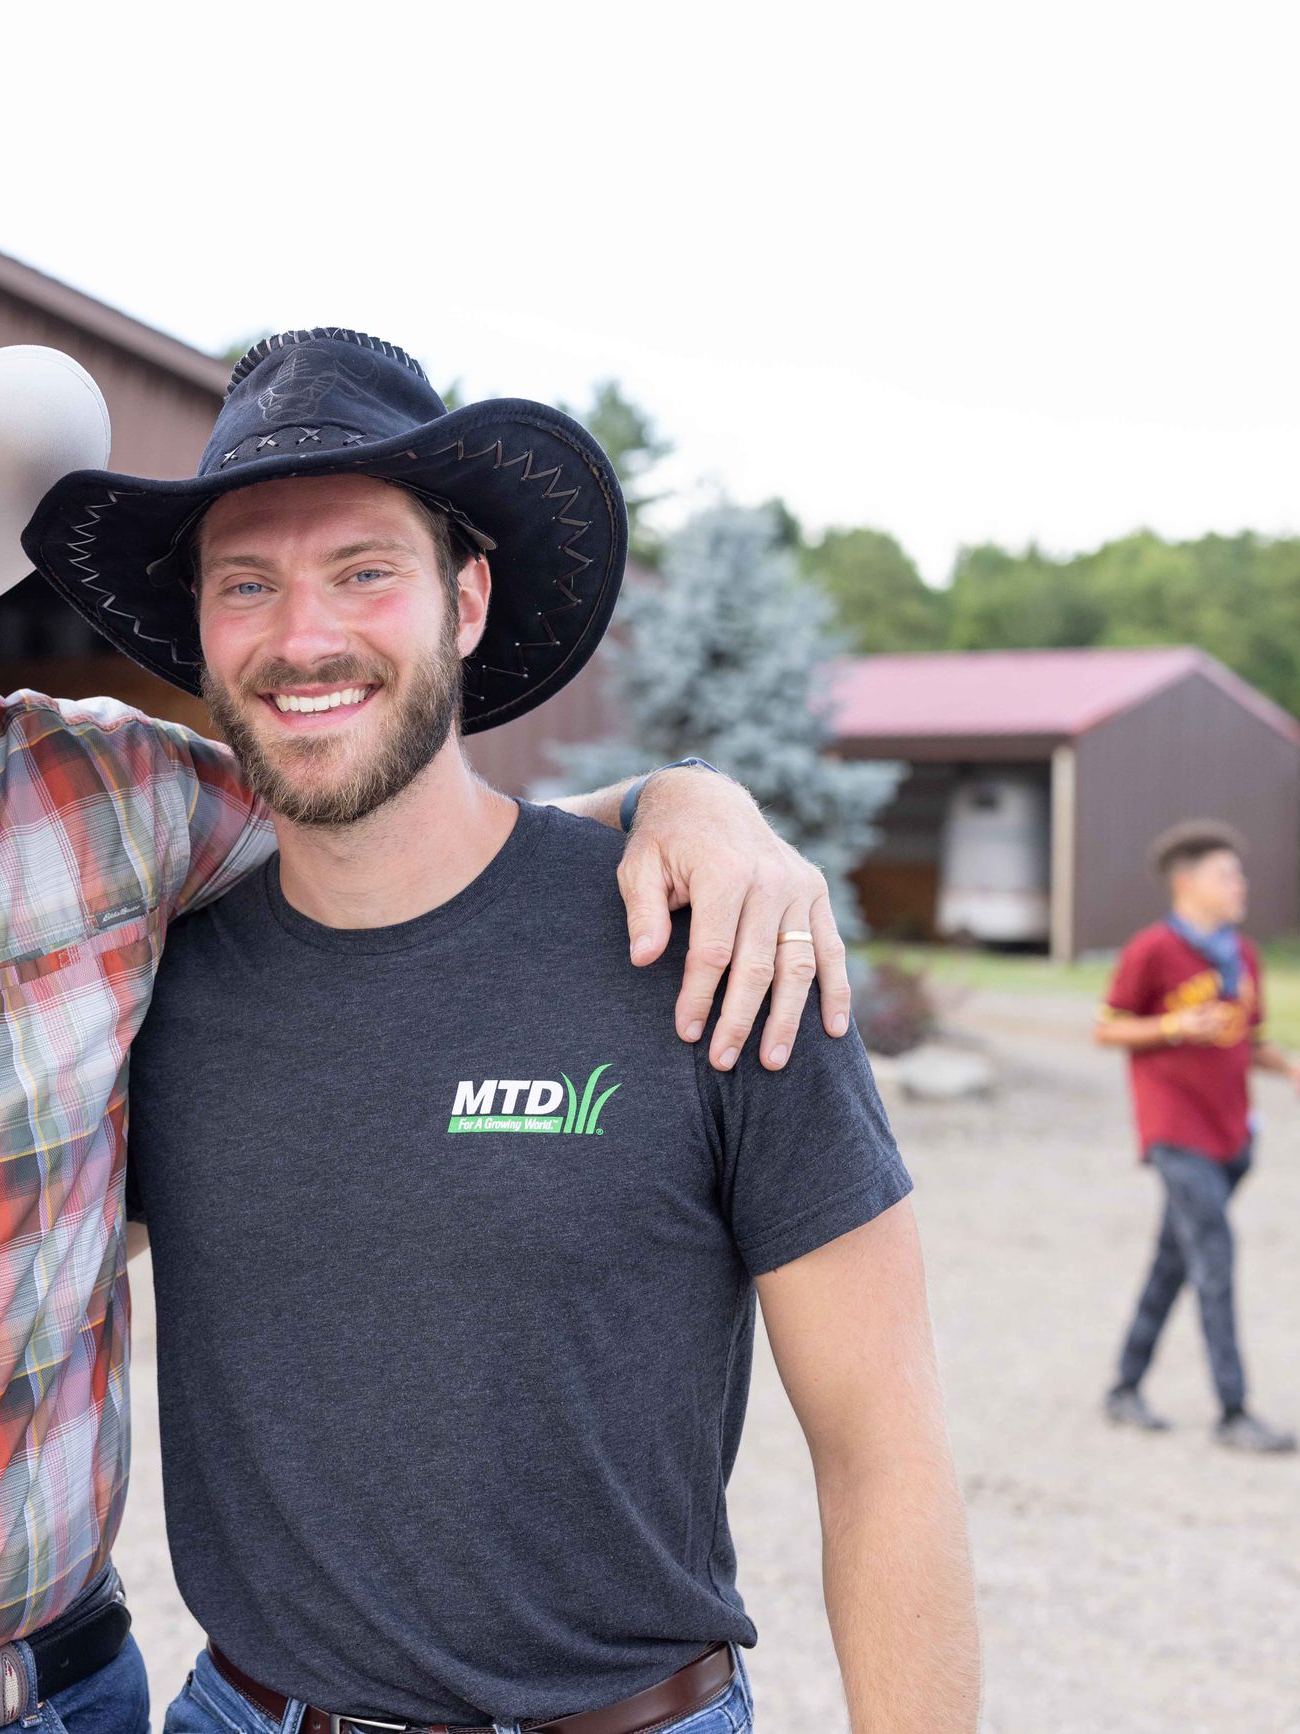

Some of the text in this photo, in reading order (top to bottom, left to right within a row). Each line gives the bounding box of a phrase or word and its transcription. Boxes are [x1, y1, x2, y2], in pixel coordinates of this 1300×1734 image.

[451, 1079, 564, 1115] MTD
[457, 1117, 474, 1130] For
[474, 1117, 484, 1130] A
[484, 1117, 522, 1132] Growing
